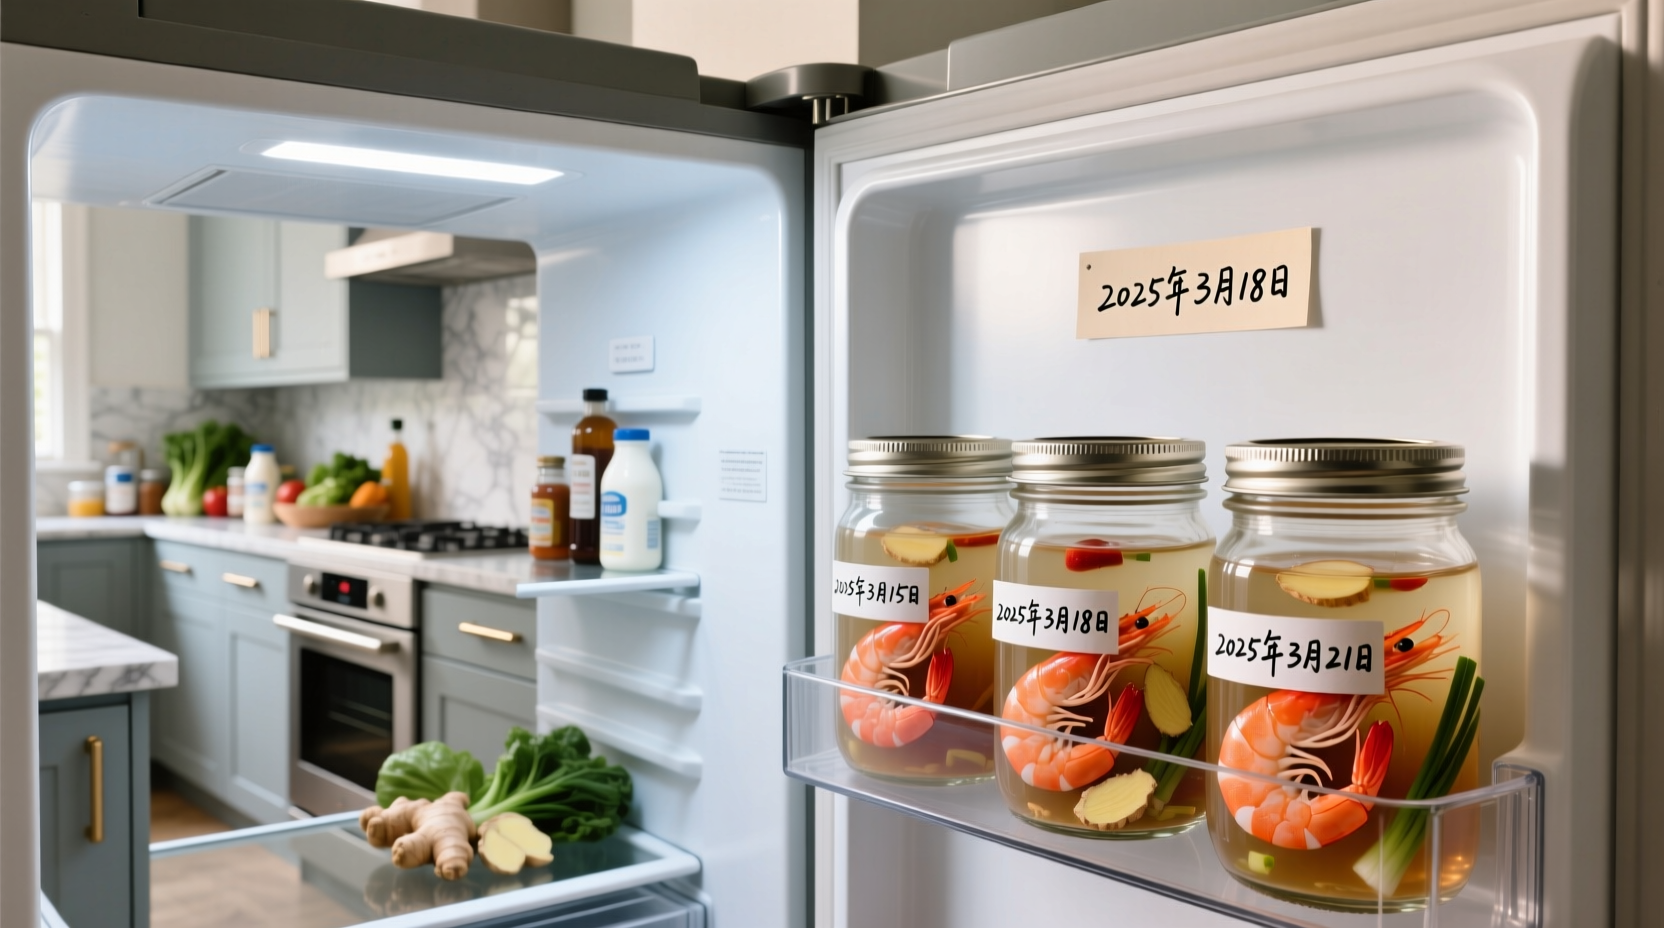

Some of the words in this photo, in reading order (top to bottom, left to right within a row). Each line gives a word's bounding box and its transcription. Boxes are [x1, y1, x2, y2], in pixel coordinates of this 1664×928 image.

[1097, 264, 1289, 317] 2025年3月18日
[996, 599, 1109, 637] 2025年3月18日
[1215, 629, 1373, 678] 2025年3月21日
